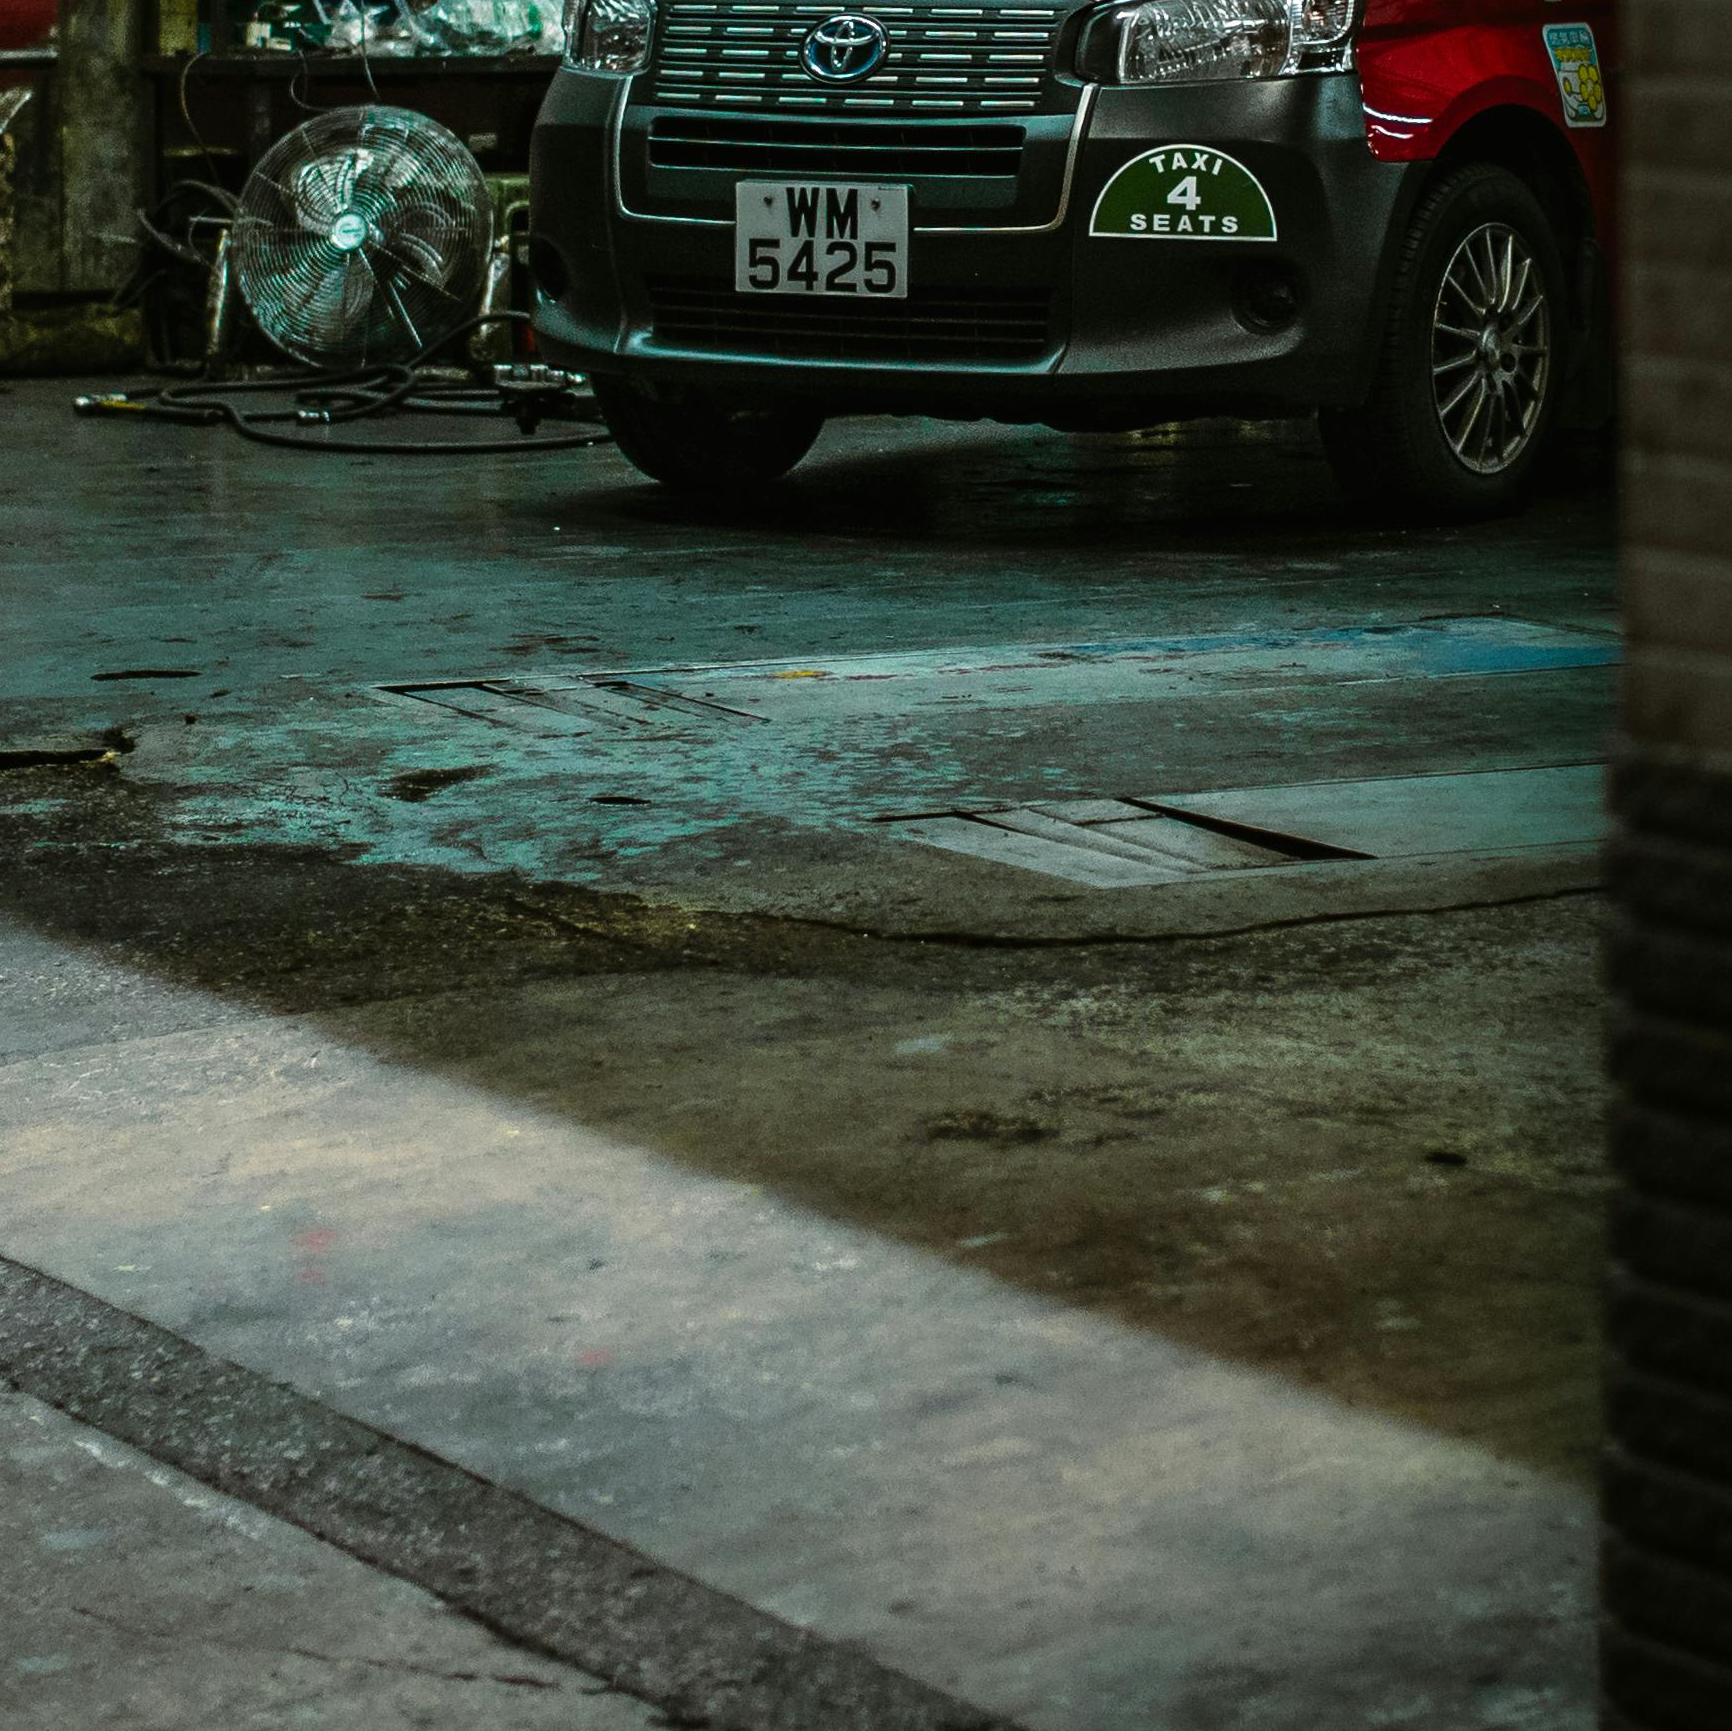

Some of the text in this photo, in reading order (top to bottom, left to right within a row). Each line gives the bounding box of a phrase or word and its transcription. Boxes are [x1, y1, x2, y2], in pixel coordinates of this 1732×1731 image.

[1148, 152, 1223, 176] TAXI
[1166, 175, 1202, 211] 4
[785, 186, 859, 240] WM
[1129, 213, 1239, 234] SEATS
[748, 238, 897, 294] 5425
